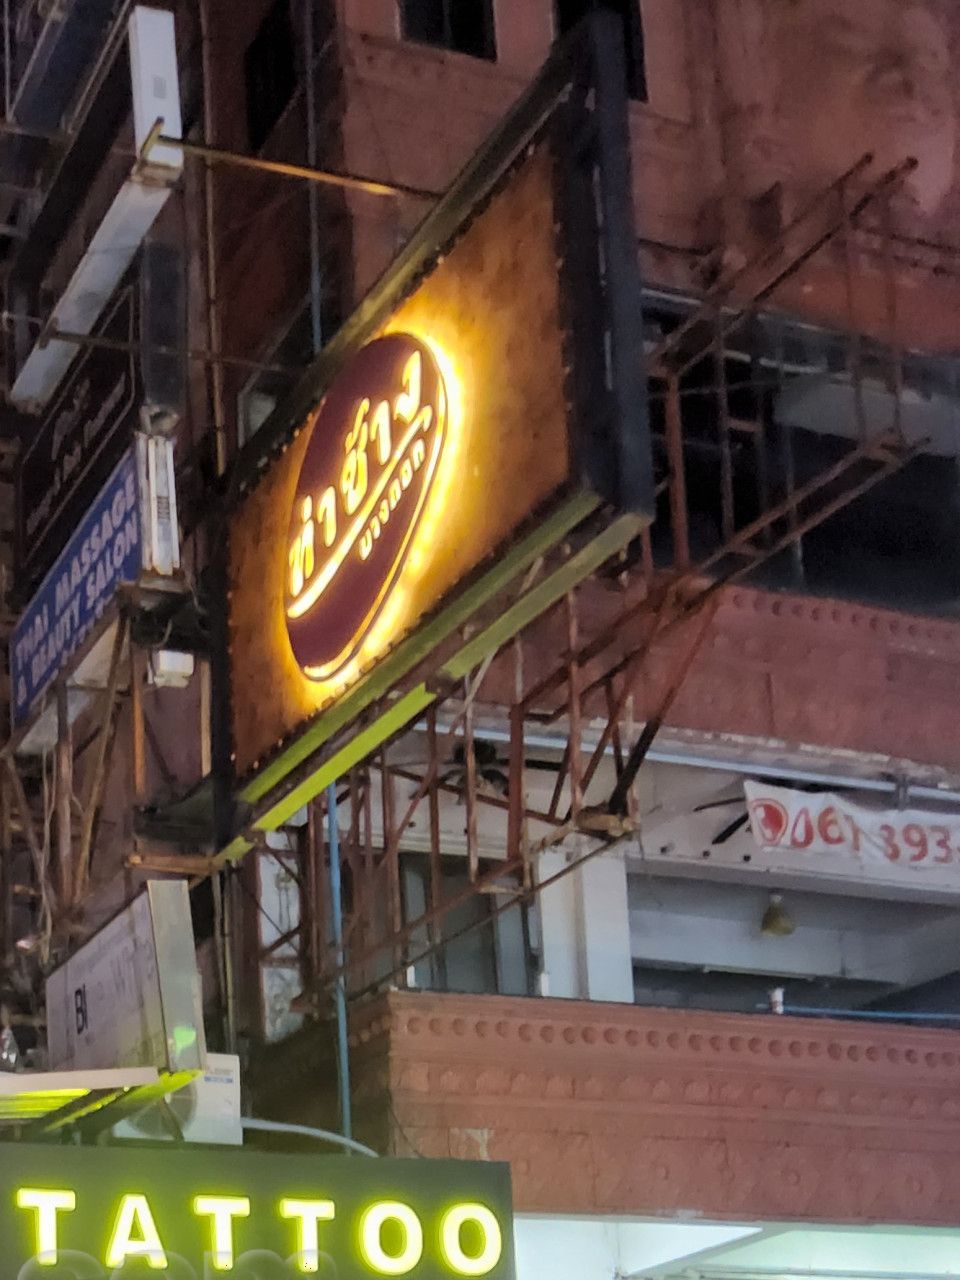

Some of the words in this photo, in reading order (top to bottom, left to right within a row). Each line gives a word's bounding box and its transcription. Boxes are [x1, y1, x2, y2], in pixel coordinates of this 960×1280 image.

[55, 468, 137, 597] MASSAGE
[31, 592, 81, 688] BEAUTY
[87, 511, 139, 609] SALON
[17, 1187, 502, 1276] TATTOO
